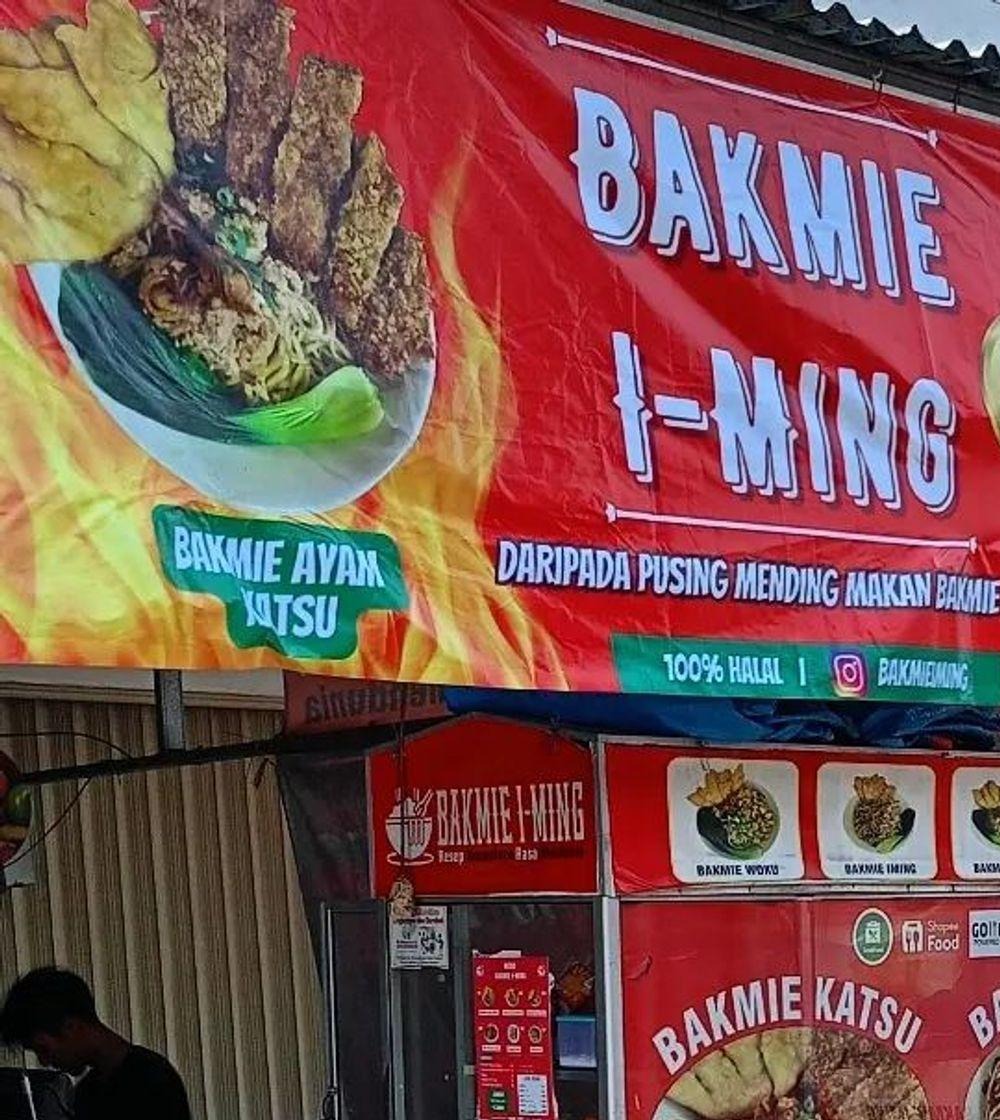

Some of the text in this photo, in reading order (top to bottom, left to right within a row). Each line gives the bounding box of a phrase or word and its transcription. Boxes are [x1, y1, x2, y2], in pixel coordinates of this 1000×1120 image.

[569, 86, 956, 308] BAKMIE
[613, 331, 956, 514] I-MING
[174, 526, 385, 588] BAKMIE AYAM
[497, 540, 631, 591] DARIPADA
[637, 553, 729, 600] PUSING
[733, 562, 840, 607] MENDING
[844, 571, 932, 608] MAKAN
[934, 574, 1000, 615] BAKMIE
[240, 586, 339, 639] KATSU
[663, 653, 784, 685] 100% HALAL
[436, 781, 585, 846] BAKMIE I-MING
[696, 864, 742, 876] BAKMIE
[844, 863, 885, 875] BAKMIE
[927, 933, 959, 951] Food
[652, 976, 922, 1075] BAKMIE KATSU
